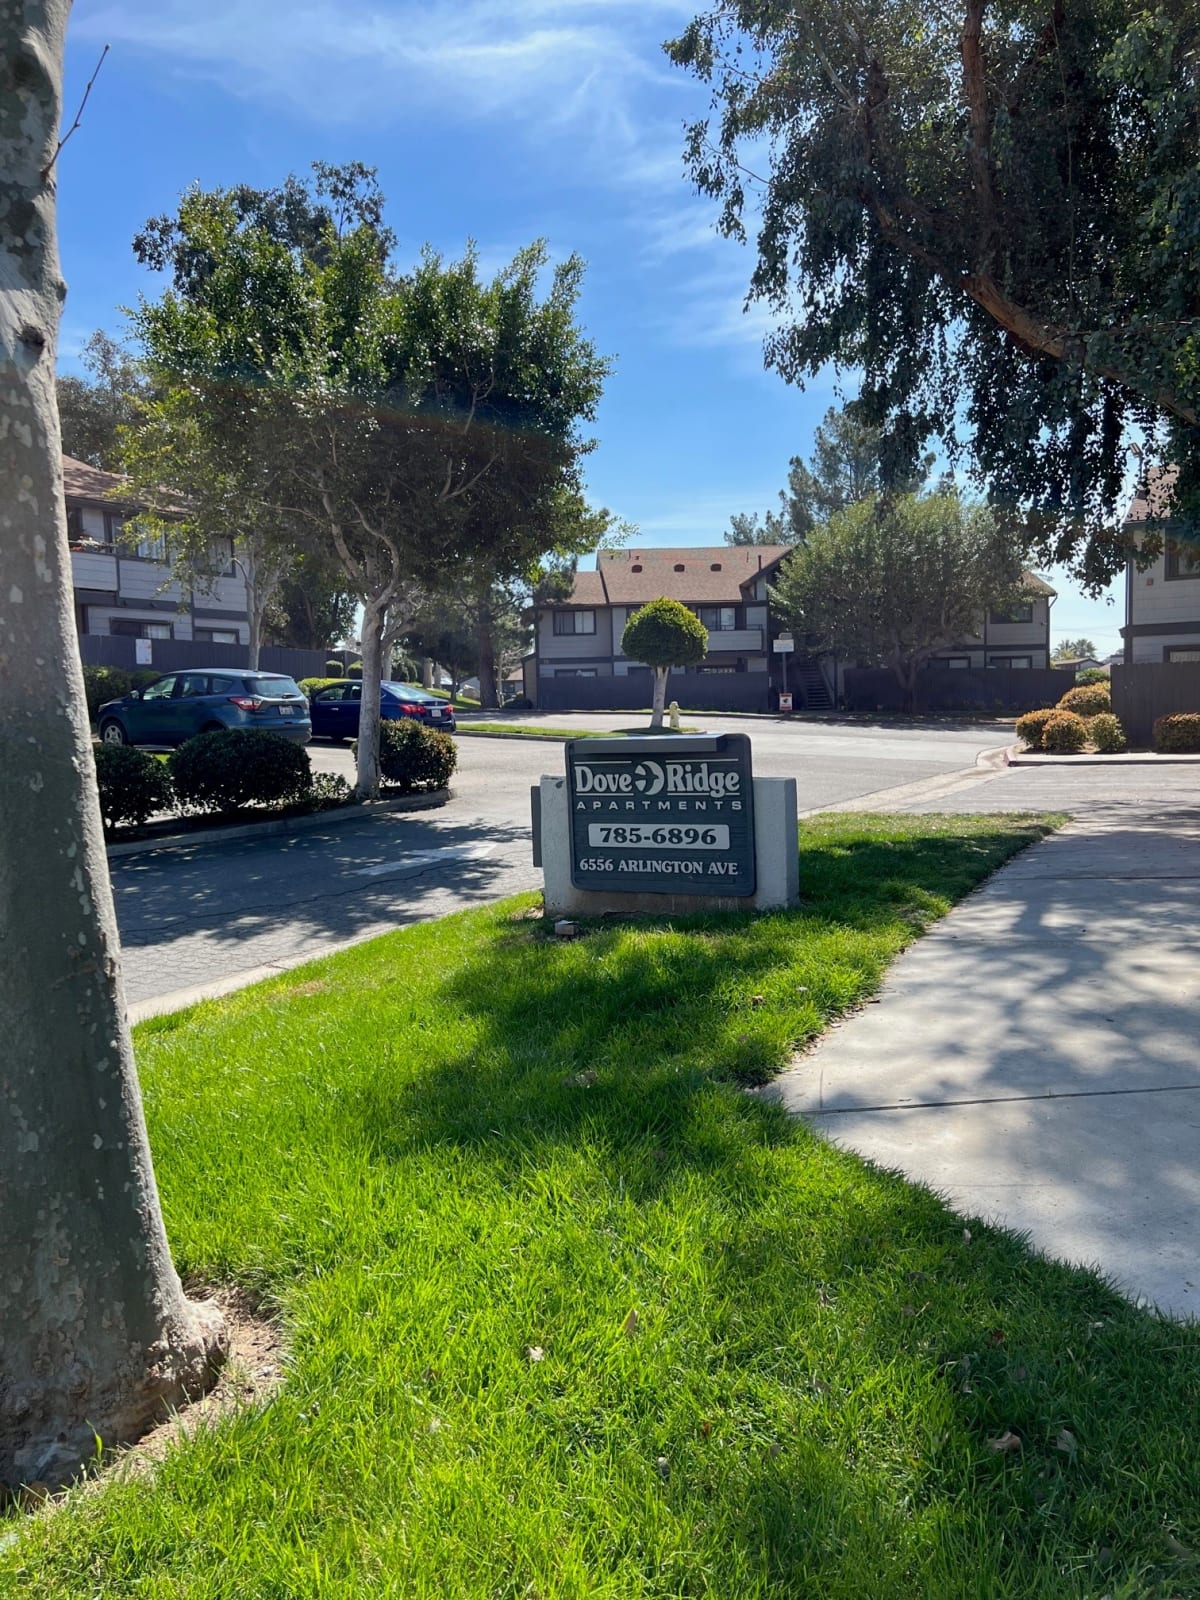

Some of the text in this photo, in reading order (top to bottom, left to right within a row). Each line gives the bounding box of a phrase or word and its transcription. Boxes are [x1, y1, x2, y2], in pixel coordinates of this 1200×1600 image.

[574, 763, 740, 798] Dove Ridge
[576, 801, 742, 810] APARTMENTS
[600, 828, 717, 844] 785-6896
[580, 858, 738, 875] 6556 ARLINGTON AVE
